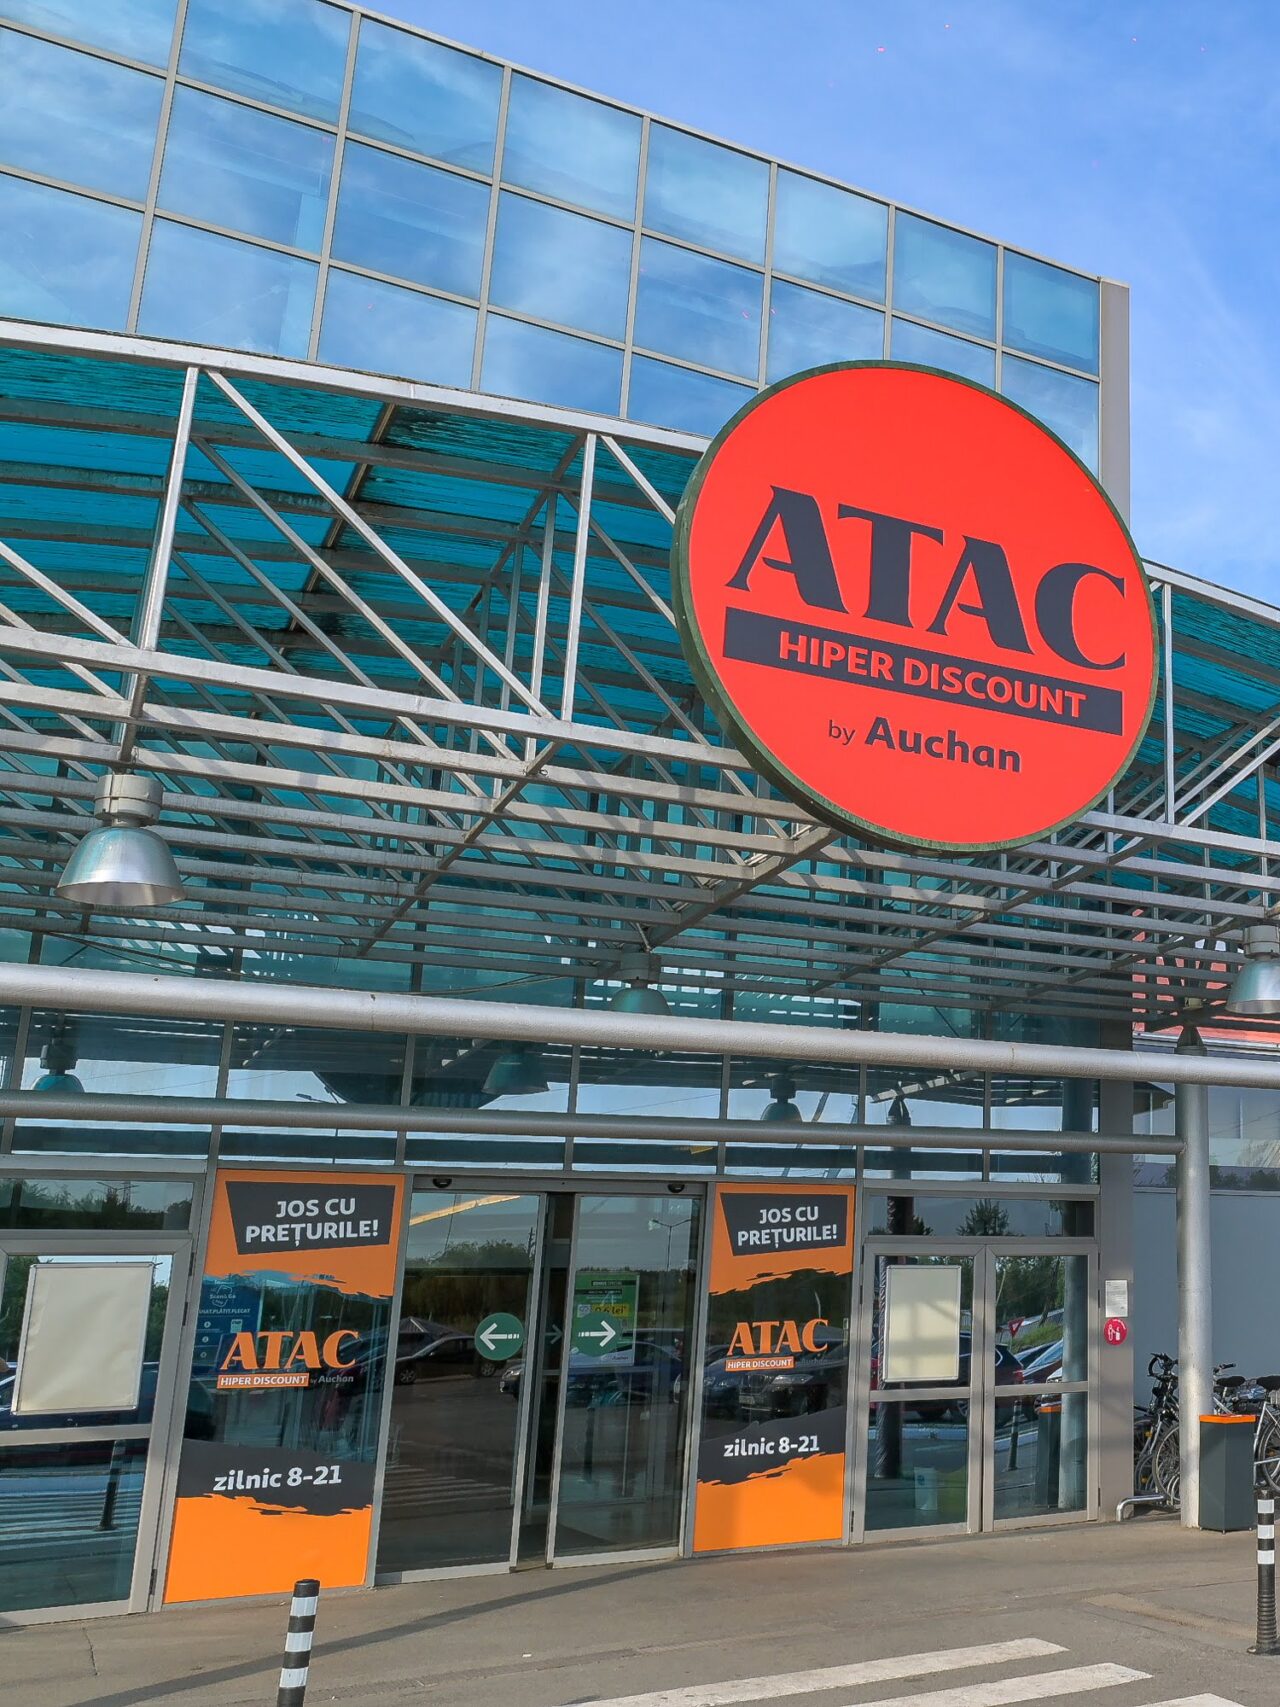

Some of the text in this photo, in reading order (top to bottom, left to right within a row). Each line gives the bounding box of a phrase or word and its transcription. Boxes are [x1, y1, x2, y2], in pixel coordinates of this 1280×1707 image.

[724, 485, 1126, 671] ATAC
[779, 630, 1087, 719] HIPER DISCOUNT
[828, 716, 1022, 773] by Auchan
[275, 1198, 356, 1218] JOS CU
[759, 1206, 819, 1224] JOS CU
[245, 1219, 379, 1247] PREȚURILE!
[738, 1224, 837, 1248] PREȚURILE!
[219, 1329, 359, 1370] ATAC
[727, 1318, 829, 1356] ATAC
[727, 1361, 752, 1369] HIPER
[752, 1359, 792, 1368] DISCOUNT
[220, 1376, 251, 1386] HIPER
[253, 1375, 307, 1385] DISCOUNT
[317, 1374, 354, 1383] Auchan
[723, 1435, 820, 1457] zilnic 8-21
[213, 1465, 342, 1491] zilnic 8-21
